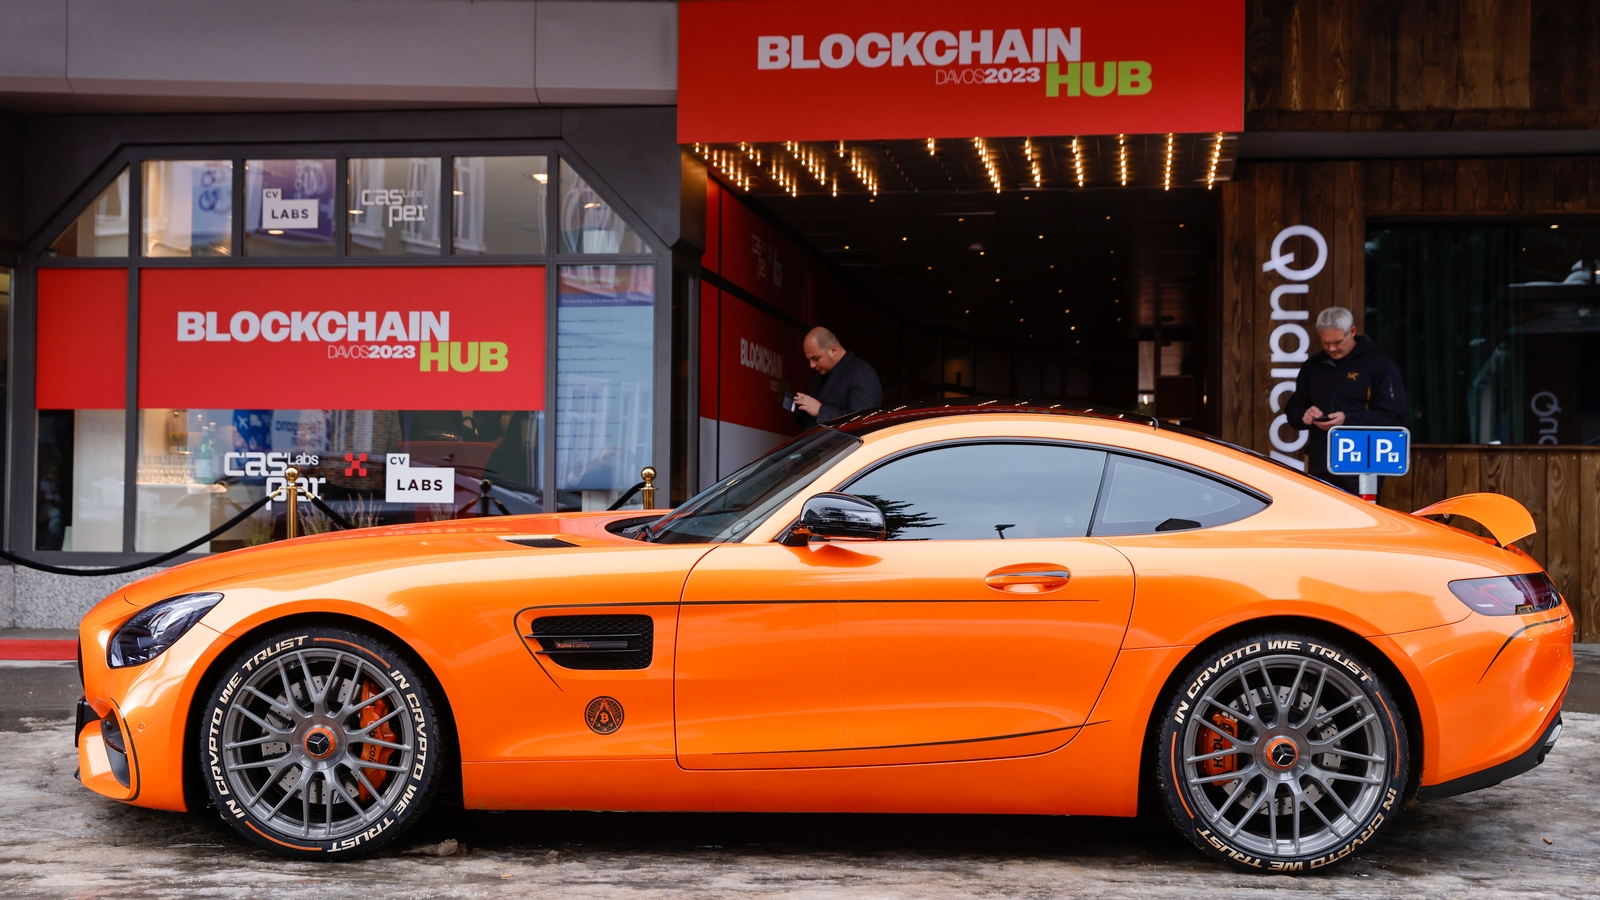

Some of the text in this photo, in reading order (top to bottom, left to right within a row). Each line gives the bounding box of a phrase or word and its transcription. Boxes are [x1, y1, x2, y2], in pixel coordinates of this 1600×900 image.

[758, 27, 1082, 70] BLOCKCHAIN
[1046, 61, 1153, 97] HUB
[403, 189, 424, 198] Labs
[271, 208, 309, 219] LABS
[177, 310, 450, 343] BLOCKCHAIN
[420, 341, 509, 373] HUB
[287, 453, 319, 465] Labs
[390, 456, 406, 465] CV
[1338, 438, 1355, 462] P
[1376, 438, 1393, 463] P
[397, 479, 443, 491] LABS
[390, 669, 411, 690] IN
[1174, 640, 1374, 725] IN CRYPTO WE TRUST
[209, 635, 309, 819] IN CRYPTO WE TRUST
[407, 692, 429, 781] CRYPTO
[394, 785, 417, 816] WE
[327, 816, 395, 853] TRUST
[1196, 787, 1397, 872] IN CRYPTO WE TRUST
